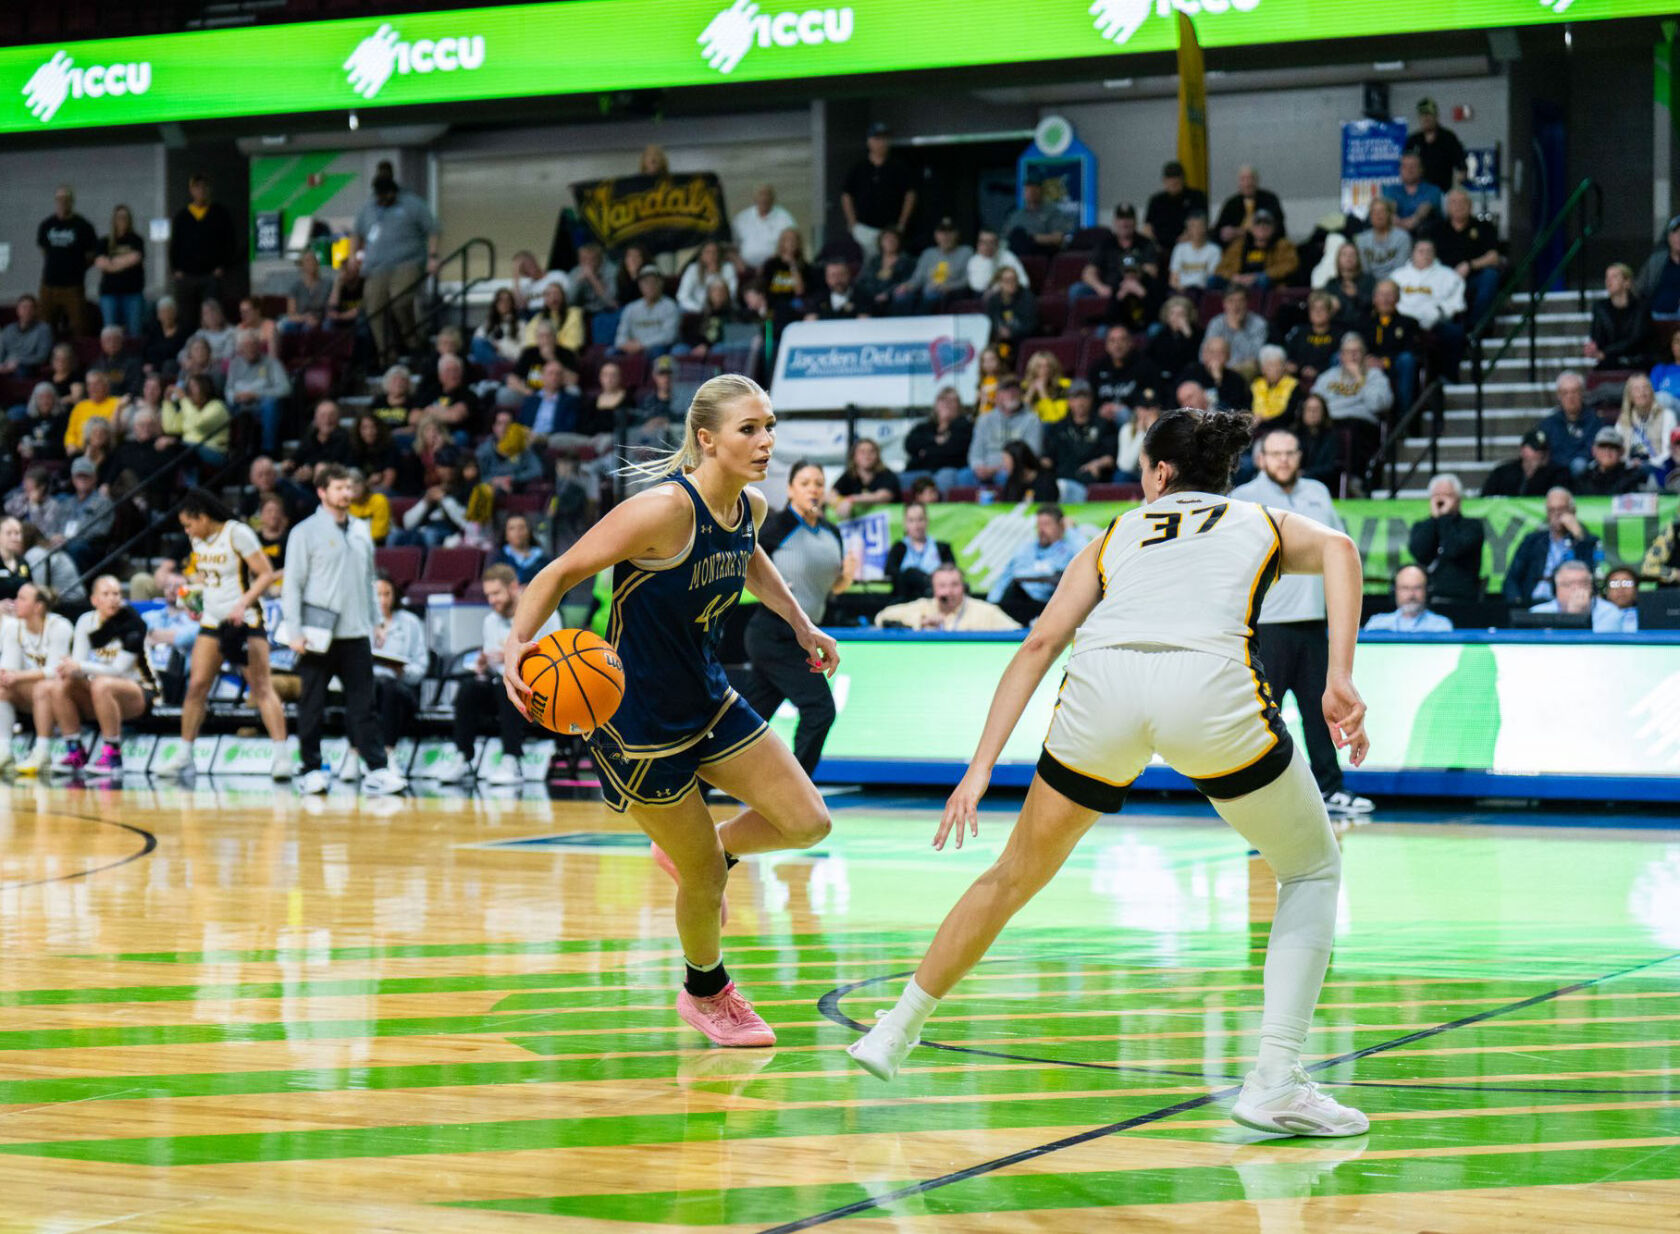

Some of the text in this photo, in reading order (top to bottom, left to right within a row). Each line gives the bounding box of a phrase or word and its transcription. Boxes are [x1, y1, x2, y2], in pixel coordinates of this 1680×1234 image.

[752, 7, 854, 47] ICCU
[393, 35, 485, 74] ICCU
[69, 62, 152, 99] ICCU
[584, 179, 720, 244] Vandals
[1140, 502, 1229, 548] 37
[688, 551, 737, 591] MONTANA
[694, 591, 739, 632] 44
